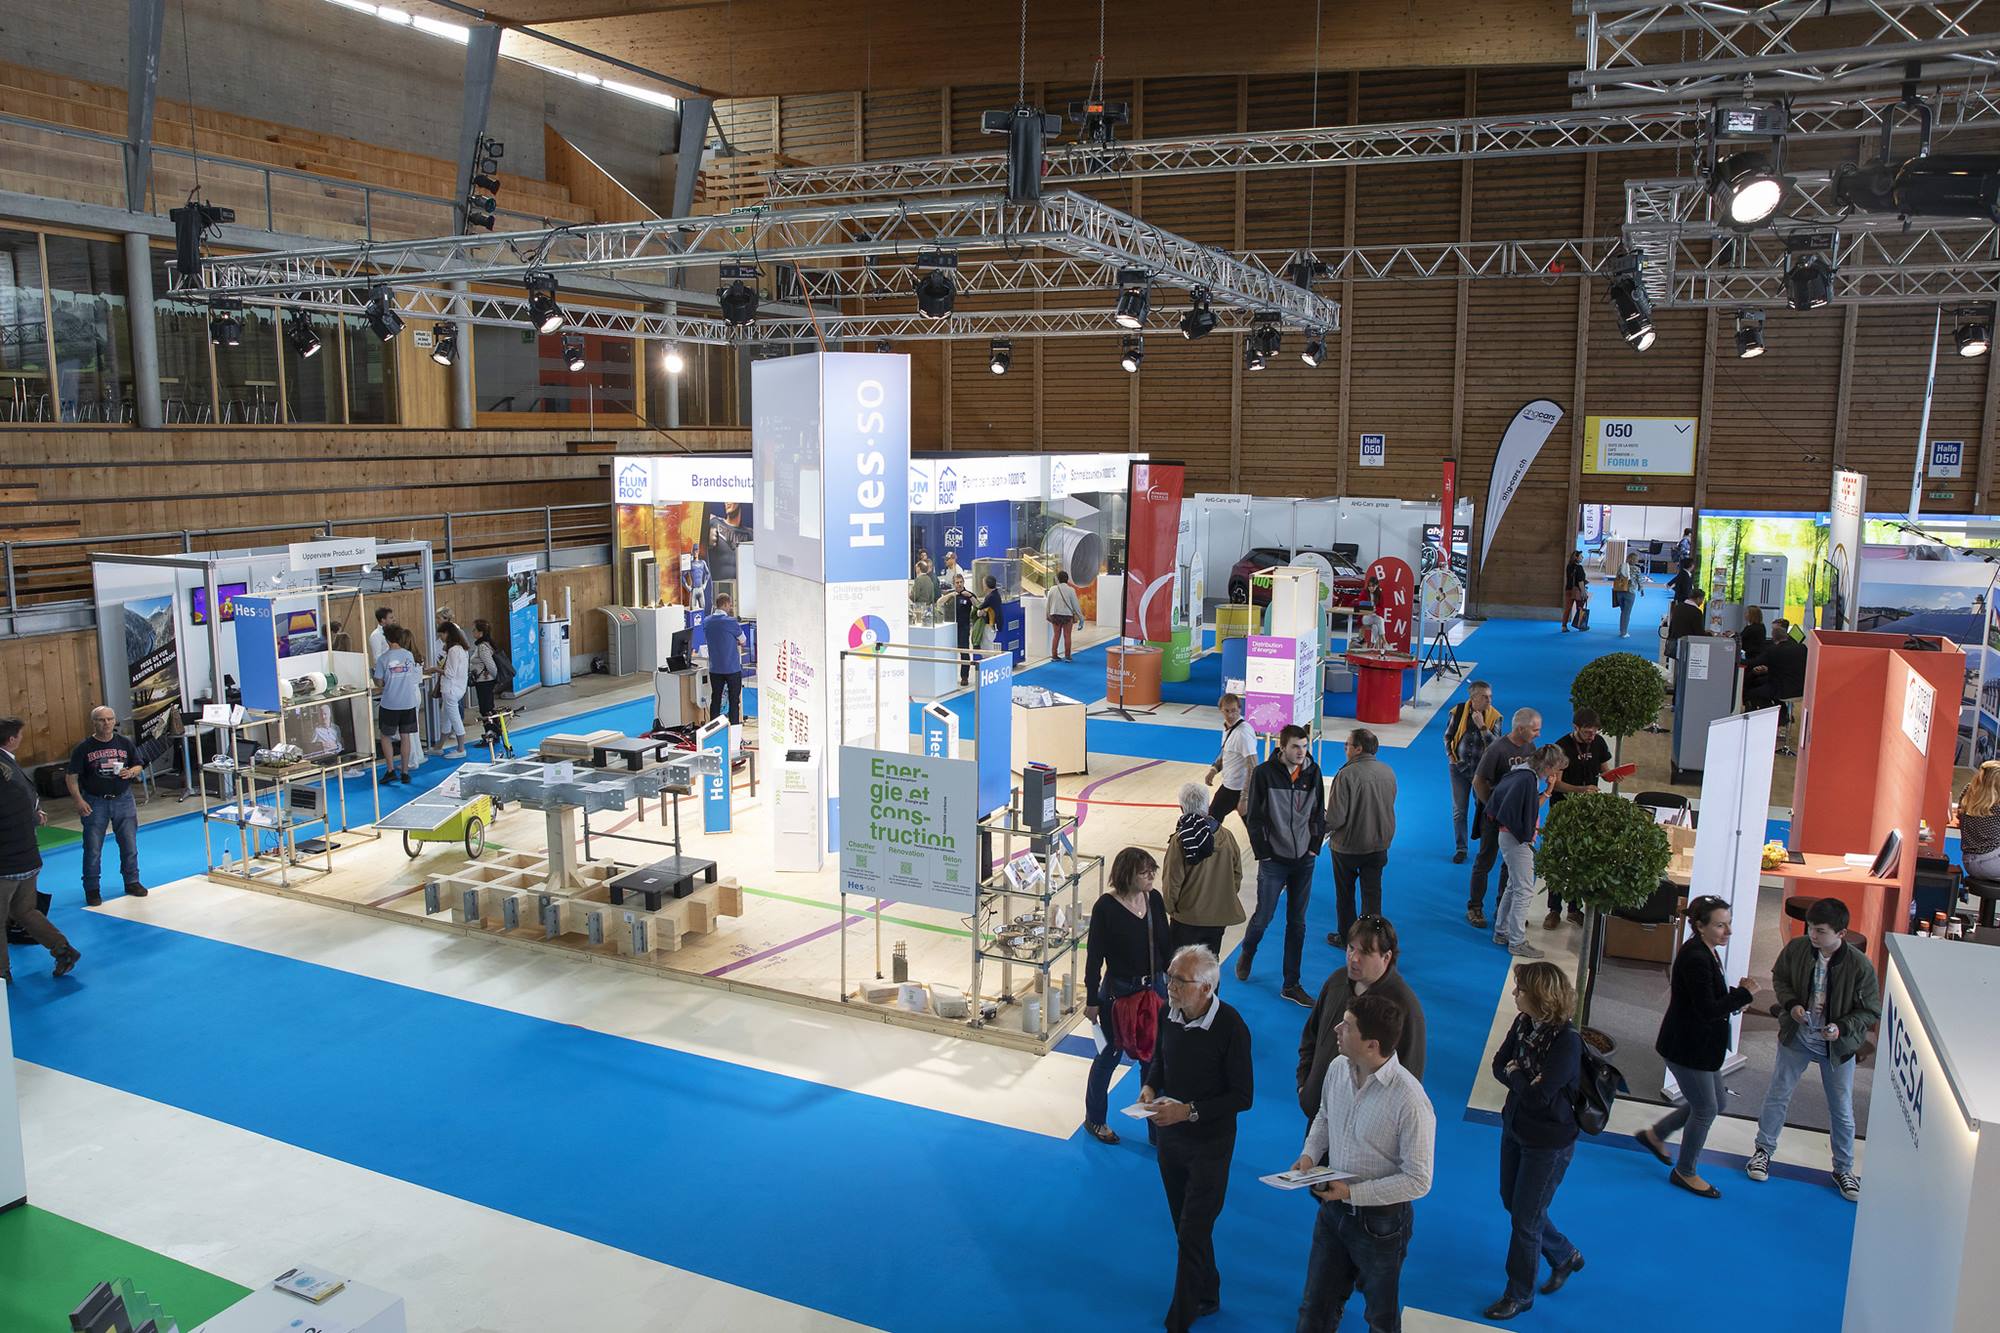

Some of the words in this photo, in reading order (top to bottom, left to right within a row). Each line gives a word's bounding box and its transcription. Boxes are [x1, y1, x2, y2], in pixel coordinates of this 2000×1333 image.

[1606, 423, 1633, 437] 050
[1364, 445, 1381, 454] 050
[1936, 444, 1958, 452] Halle
[1607, 458, 1639, 467] FORUM
[1641, 458, 1649, 467] B
[1935, 453, 1958, 464] 050
[618, 476, 648, 487] FLUM
[1502, 459, 1528, 501] ahg-cars.ch
[938, 480, 957, 492] FLUM
[618, 487, 643, 498] ROC
[938, 492, 954, 505] ROC
[945, 533, 963, 541] FLUM
[1426, 526, 1465, 537] ahgars
[302, 551, 332, 561] Upperview
[865, 631, 872, 640] 6
[1251, 640, 1283, 649] Distribution
[158, 649, 168, 658] VUE
[153, 660, 162, 669] PAR
[871, 757, 929, 779] Ener-
[869, 781, 903, 804] gie
[908, 786, 930, 801] et
[870, 804, 931, 826] cons-
[870, 820, 956, 849] truction
[848, 840, 876, 851] Chauffer
[888, 846, 925, 858] Rénovation
[942, 854, 963, 864] Béton
